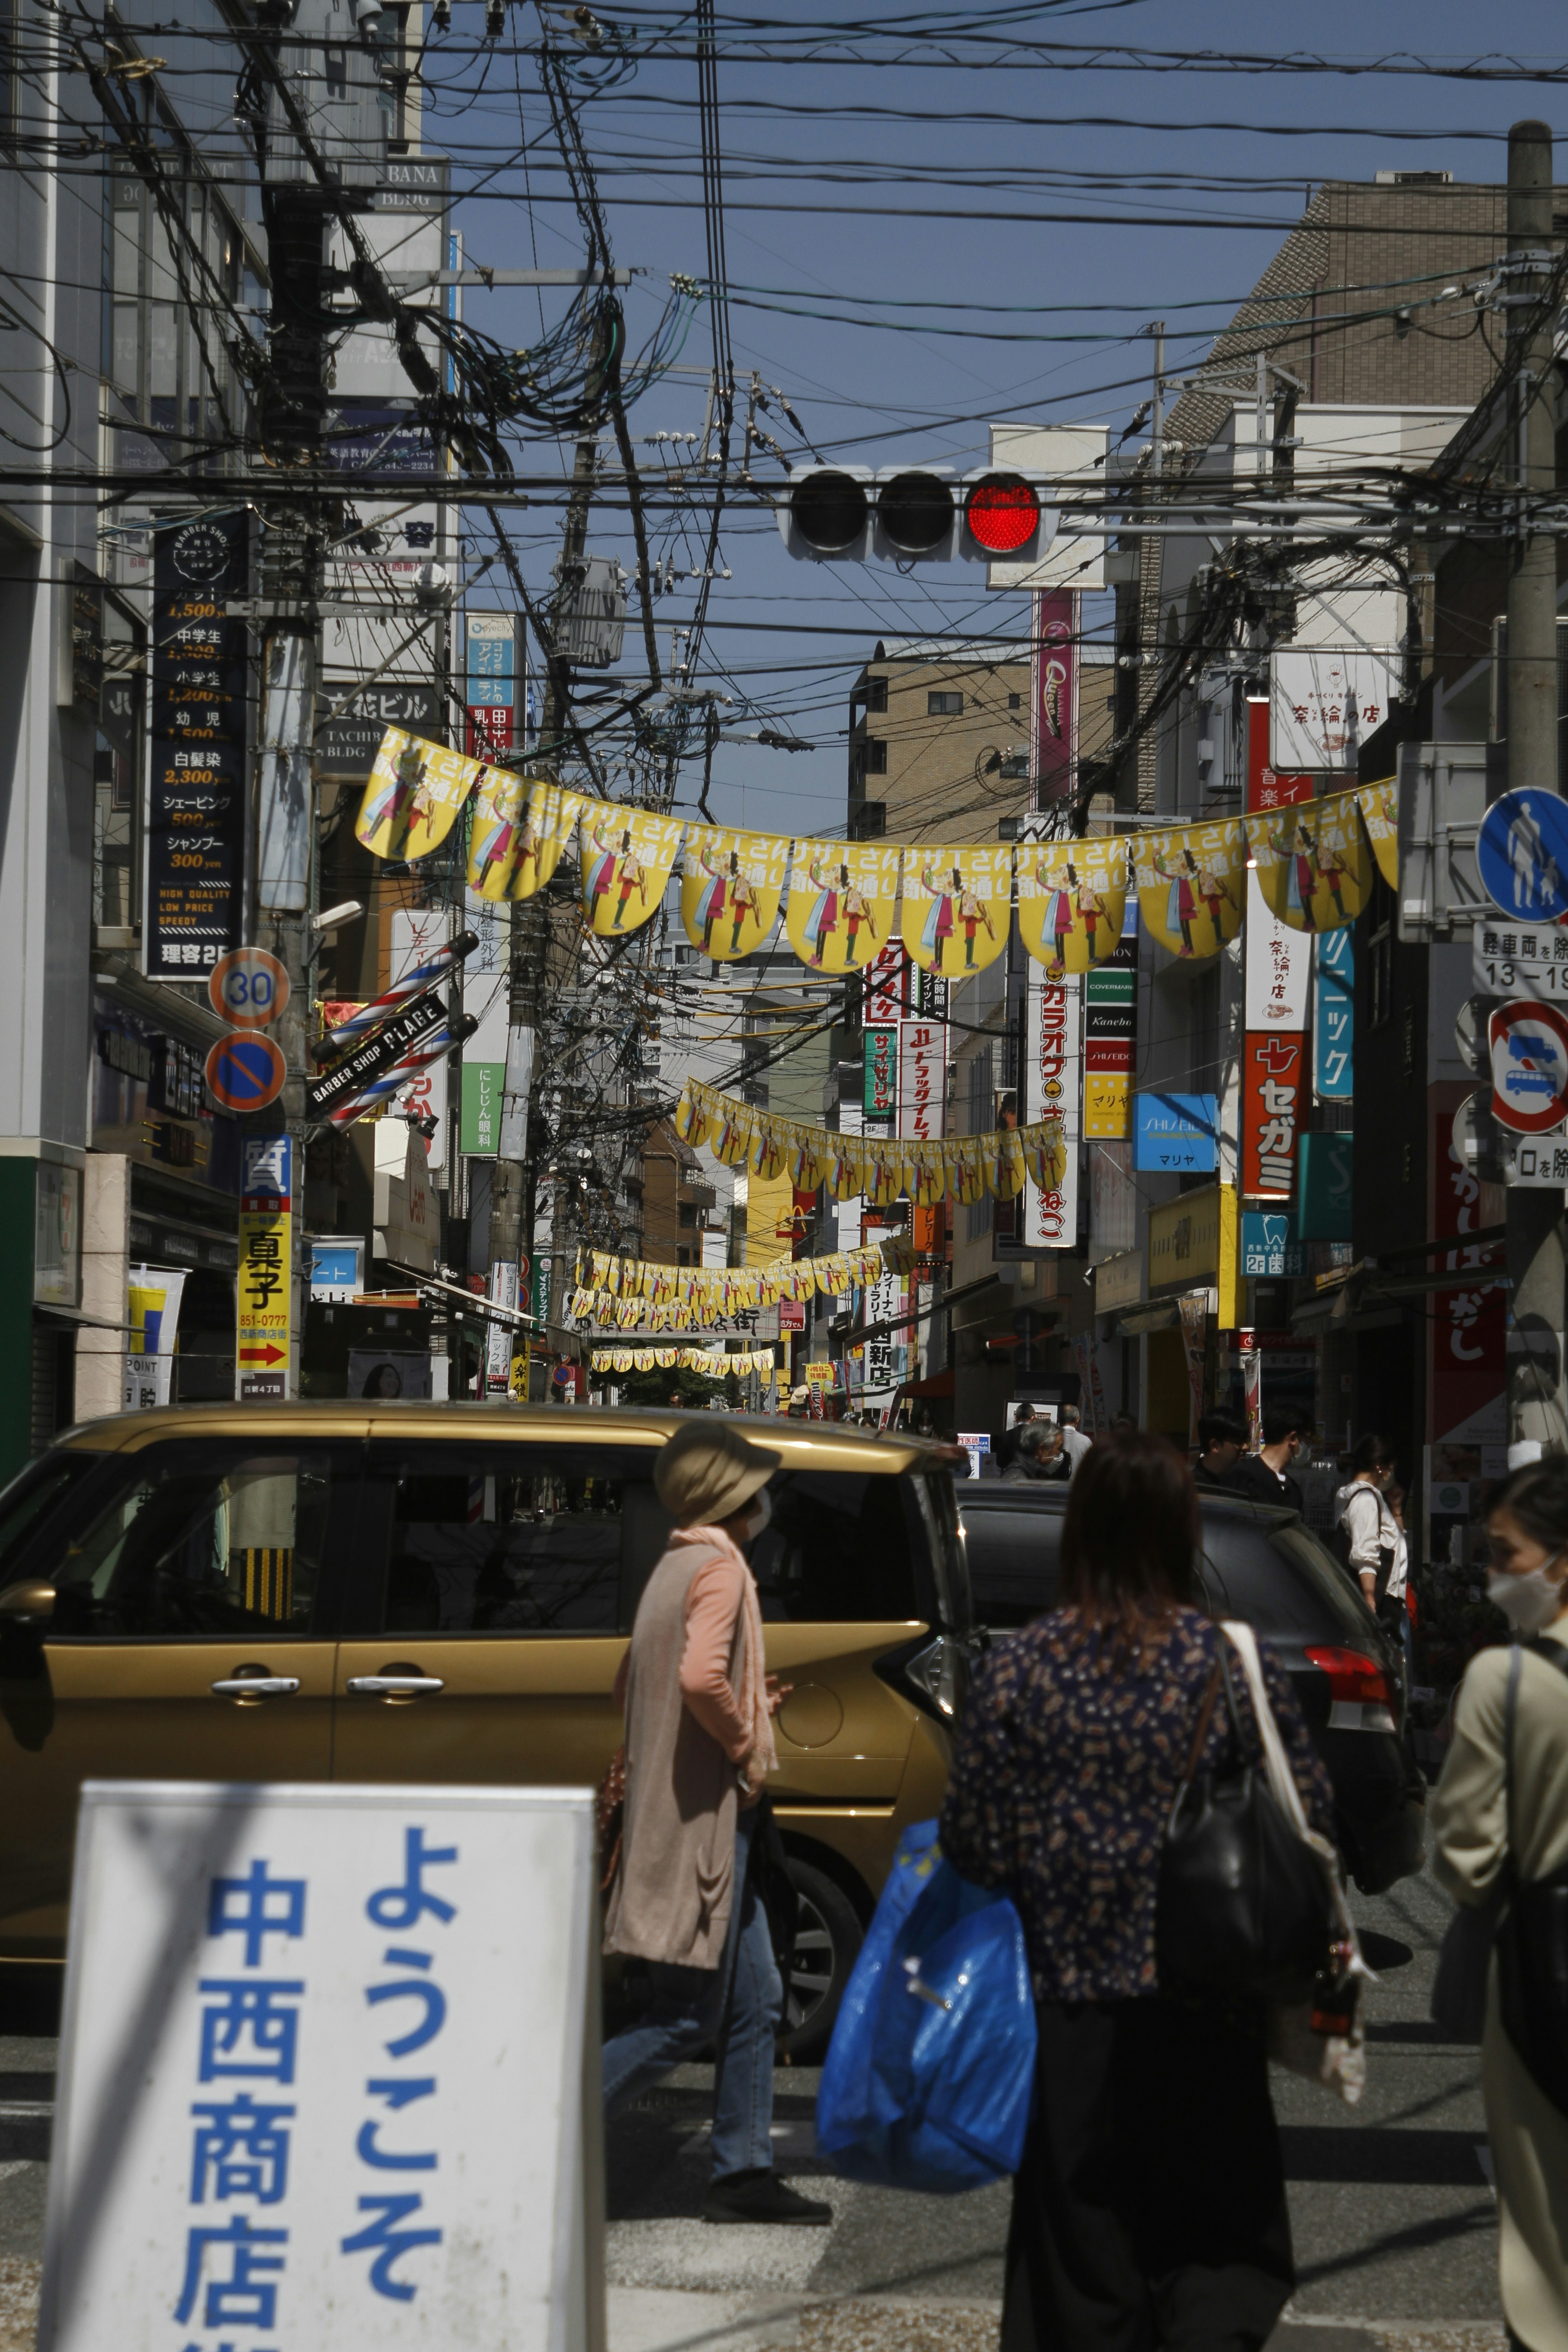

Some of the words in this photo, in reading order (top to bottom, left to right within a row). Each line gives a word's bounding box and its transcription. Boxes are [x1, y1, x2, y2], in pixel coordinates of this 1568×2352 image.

[389, 165, 438, 182] BANA
[168, 603, 215, 618] 1,500
[177, 629, 221, 643] 中学生
[484, 623, 511, 633] eyecity
[176, 671, 220, 686] 小学生
[167, 688, 214, 703] 1,200
[328, 692, 428, 720] 立花ビル
[327, 730, 381, 742] TACHIB
[175, 752, 221, 768] 白髪染
[328, 747, 365, 762] BLDG
[380, 730, 479, 784] サザエさん
[164, 770, 213, 786] 2,300
[478, 769, 580, 822] サザエさん
[1260, 768, 1278, 807] 音楽
[163, 796, 231, 810] シェービング
[171, 813, 204, 827] 500
[581, 801, 681, 845] サザエさん
[1246, 797, 1355, 842] サザエさん
[167, 837, 224, 851] シャンプー
[686, 825, 789, 861] サザエさん
[1130, 821, 1242, 862] サザエさん
[170, 854, 203, 868] 300
[204, 860, 222, 871] yen
[792, 841, 900, 872] サザエさん
[903, 848, 1011, 872] サザエさん
[1016, 844, 1127, 869] サザエさん
[160, 889, 184, 899] HIGH
[188, 890, 230, 899] QUALITY
[159, 903, 179, 912] LOW
[185, 904, 214, 912] PRICE
[159, 916, 197, 926] SPEEDY
[229, 971, 272, 1005] 30
[1324, 931, 1349, 1085] リニック
[1092, 1017, 1132, 1027] Kanebo
[1042, 984, 1065, 1078] カラオケ
[313, 1068, 354, 1102] BARBER
[352, 1045, 382, 1074] SHOP
[383, 1002, 437, 1049] PLAGE
[1089, 1052, 1134, 1060] SHISEIDO
[872, 1034, 892, 1112] サイゼリヤ
[478, 1069, 491, 1147] にしじん眼科
[1092, 1095, 1130, 1108] マリヤ
[1140, 1118, 1214, 1131] SHISEIDO
[1258, 1078, 1296, 1189] セガミ
[245, 1140, 287, 1193] 質
[1160, 1155, 1194, 1166] マリヤ
[1512, 1148, 1568, 1179] 口を除
[245, 1230, 283, 1310] 真子
[1248, 1257, 1264, 1271] 2F
[1269, 1253, 1302, 1274] 歯科
[871, 1283, 879, 1323] ャラリー
[240, 1315, 287, 1327] 851-0777
[780, 1319, 802, 1329] 処方せん
[240, 1329, 286, 1340] 西新商店街
[341, 1827, 458, 2303] ようこそ
[172, 1859, 308, 2352] 中西商店
